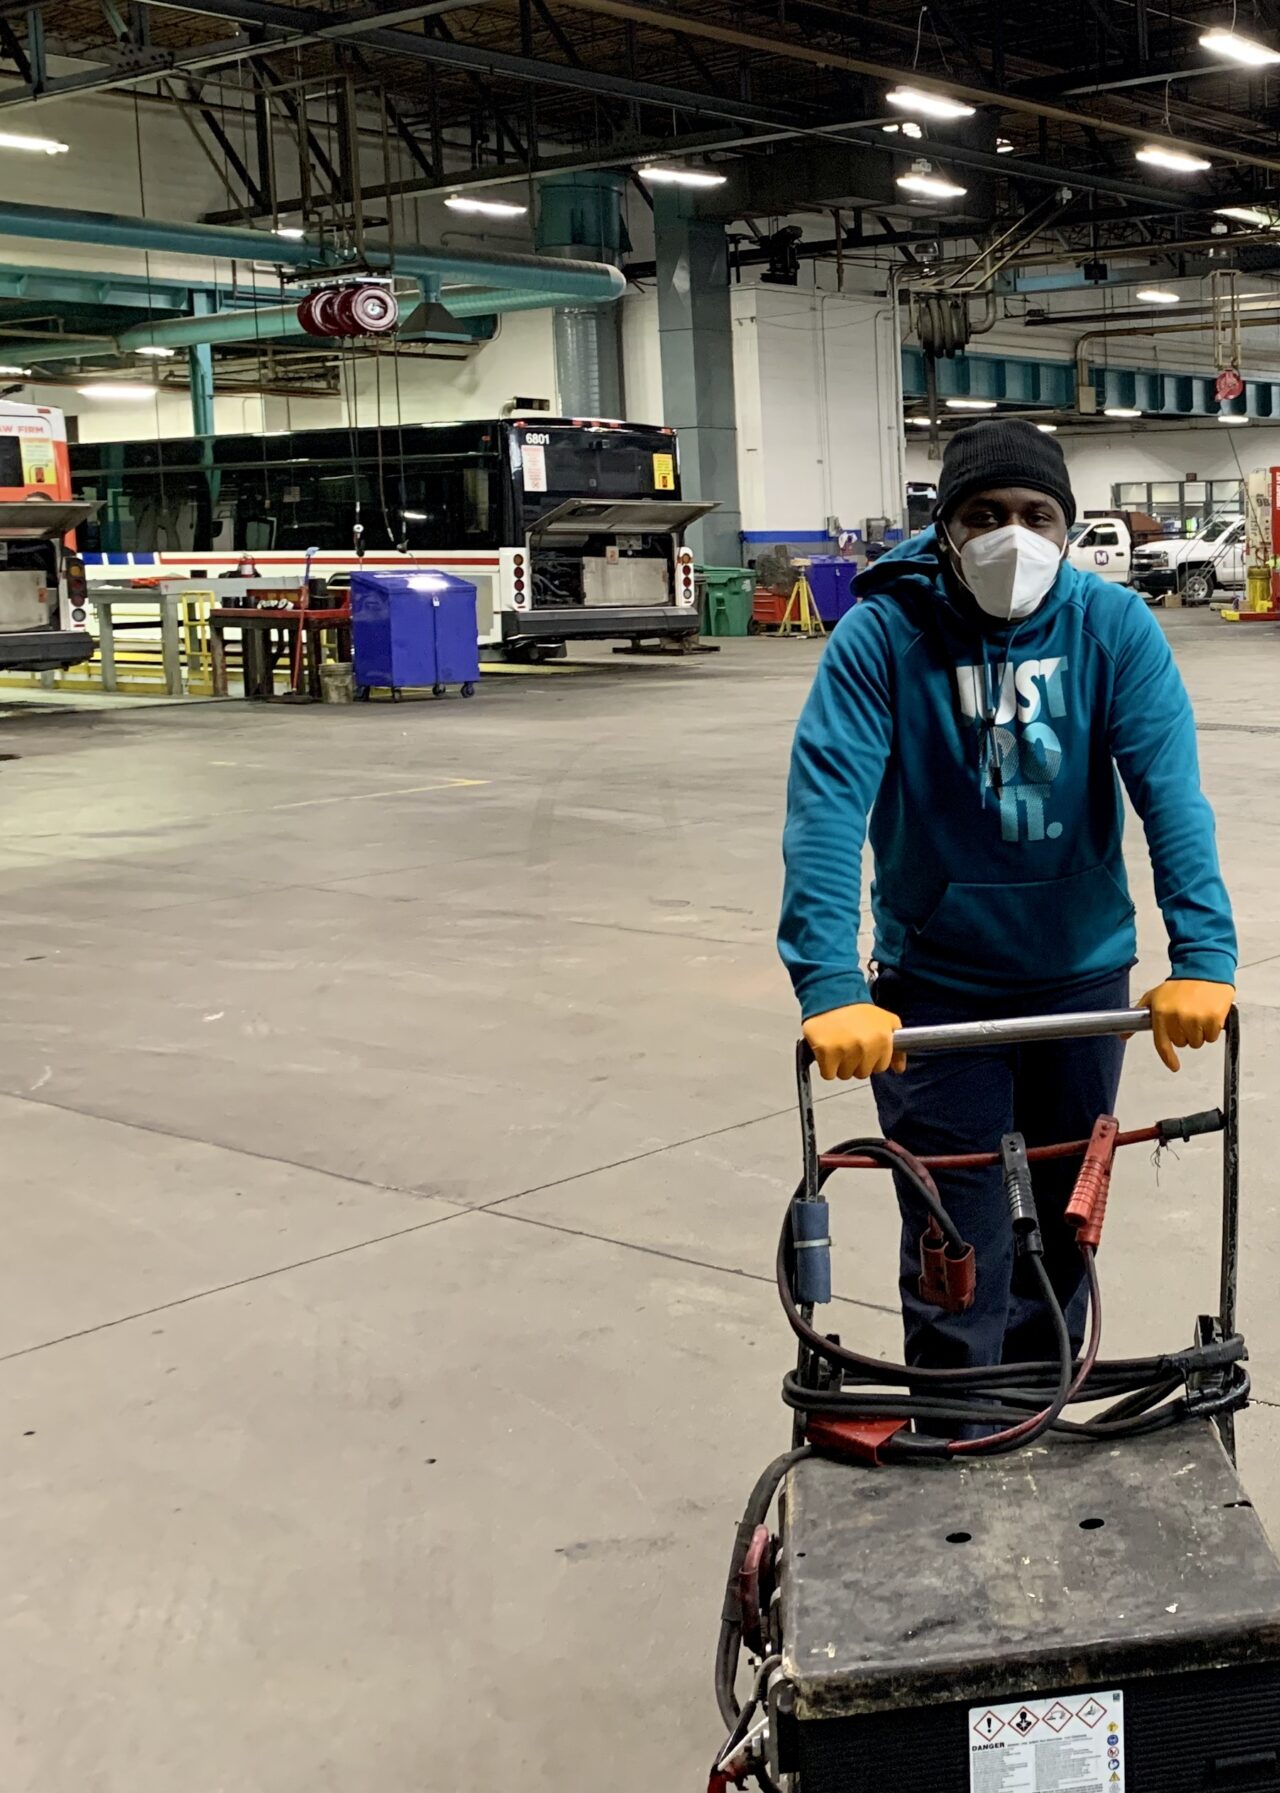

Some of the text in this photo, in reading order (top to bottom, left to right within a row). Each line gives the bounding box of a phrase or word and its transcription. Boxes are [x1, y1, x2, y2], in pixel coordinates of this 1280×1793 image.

[525, 433, 550, 445] 6801
[956, 656, 1069, 726] JUST
[971, 1742, 1005, 1752] DANGER
